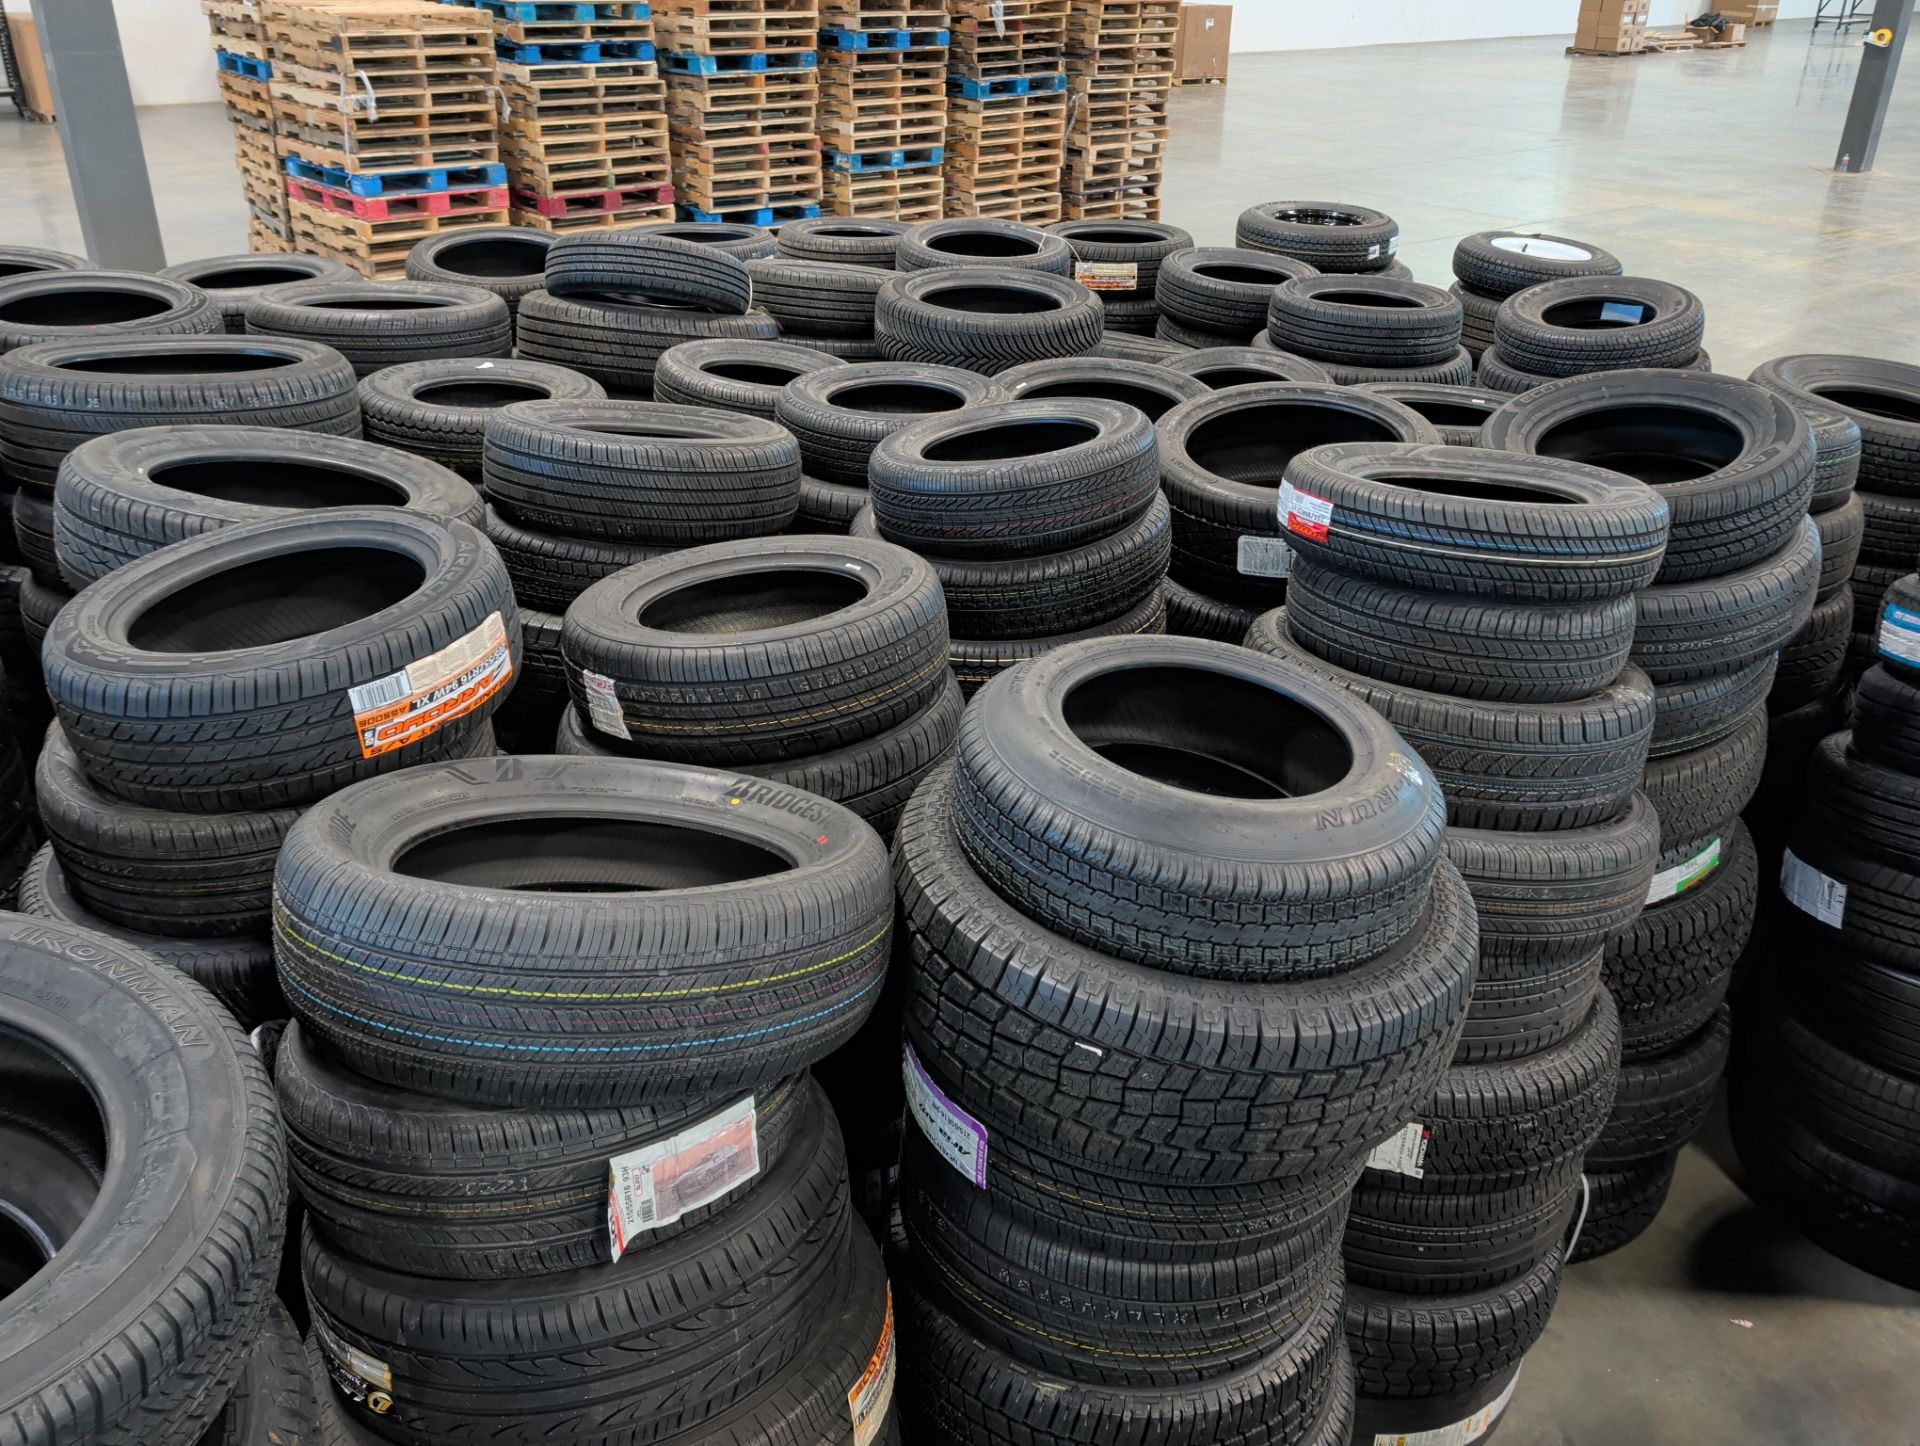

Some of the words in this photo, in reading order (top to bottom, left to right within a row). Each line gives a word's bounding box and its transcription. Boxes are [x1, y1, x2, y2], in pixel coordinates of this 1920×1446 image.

[432, 680, 460, 699] 94W
[412, 693, 431, 710] XL
[9, 926, 210, 1048] IRONMAN
[620, 1166, 632, 1183] 93H
[623, 1185, 635, 1226] 215/55R16
